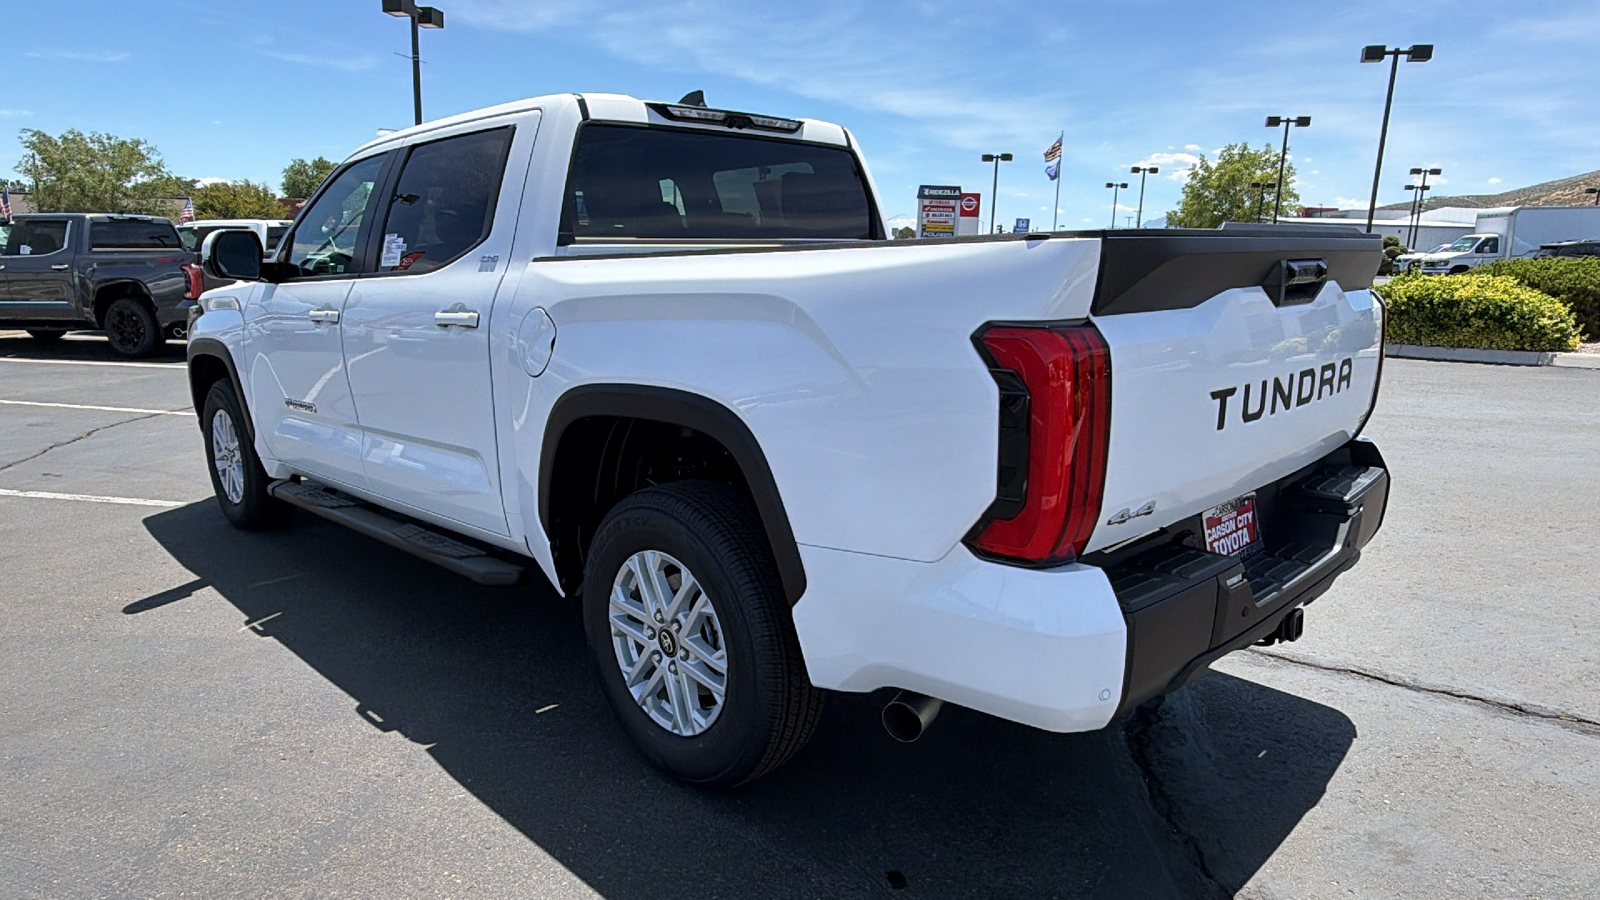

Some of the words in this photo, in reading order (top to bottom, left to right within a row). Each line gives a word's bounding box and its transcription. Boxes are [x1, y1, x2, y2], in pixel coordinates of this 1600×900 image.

[1210, 358, 1352, 430] TUNDRA
[1206, 519, 1236, 543] CARSON
[1237, 511, 1253, 528] CITY
[1213, 527, 1251, 556] TOYOTA
